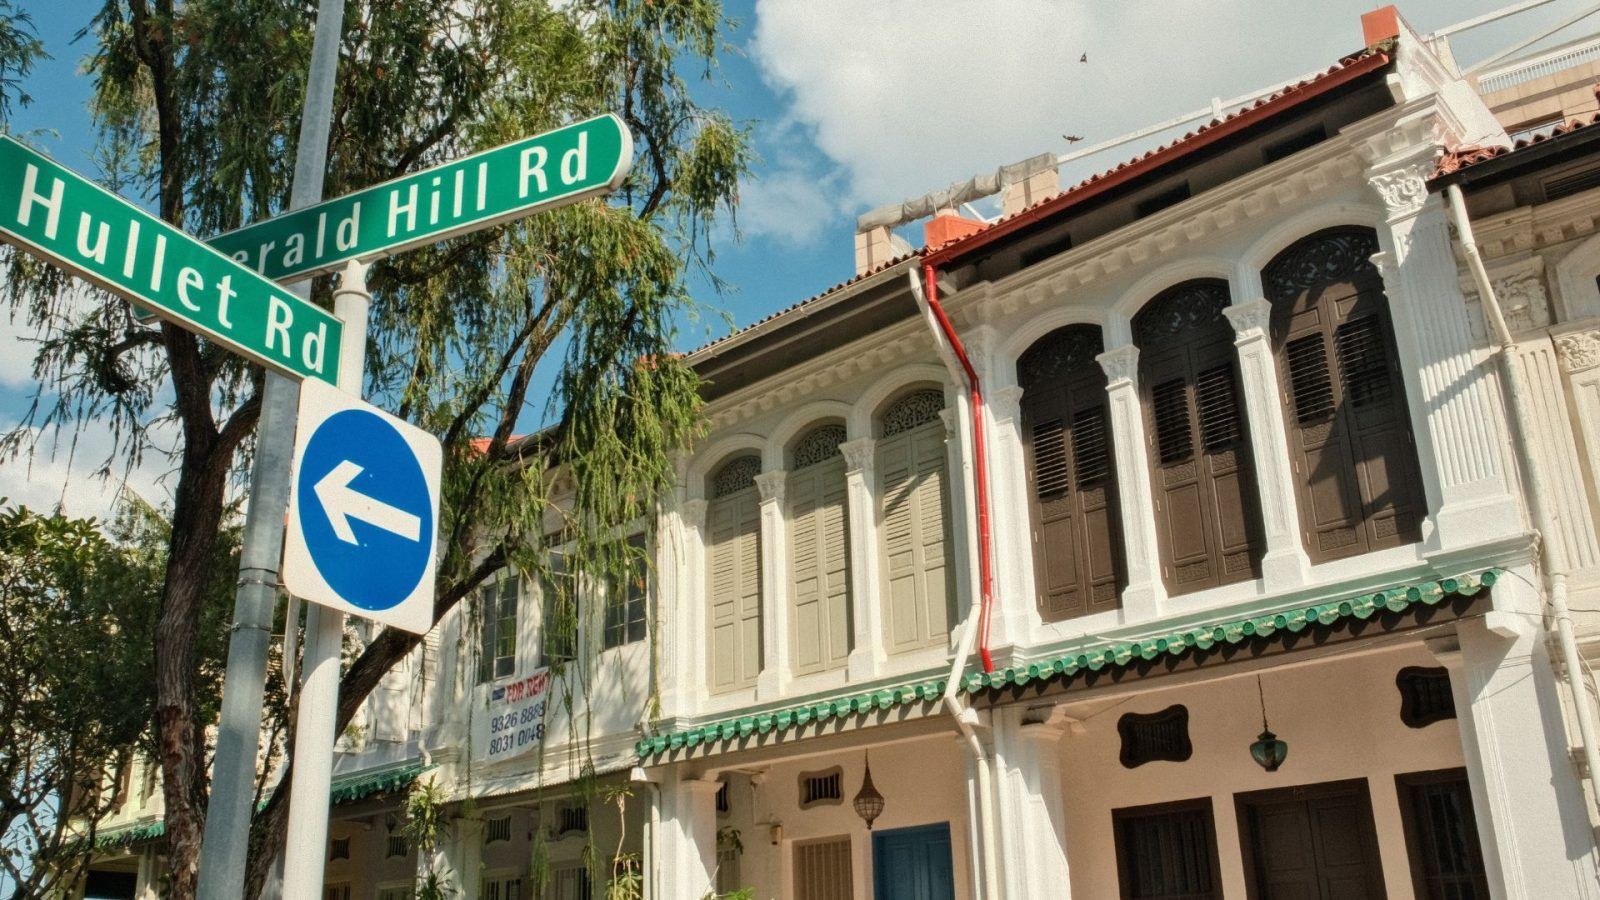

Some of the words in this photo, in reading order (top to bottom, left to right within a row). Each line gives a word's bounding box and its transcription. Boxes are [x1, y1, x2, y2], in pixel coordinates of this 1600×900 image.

[388, 163, 488, 237] Hill
[519, 130, 589, 198] Rd
[17, 163, 238, 330] Hullet
[264, 296, 326, 374] Rd
[506, 681, 524, 704] FOR
[491, 712, 518, 734] 9326
[489, 733, 514, 755] 8031
